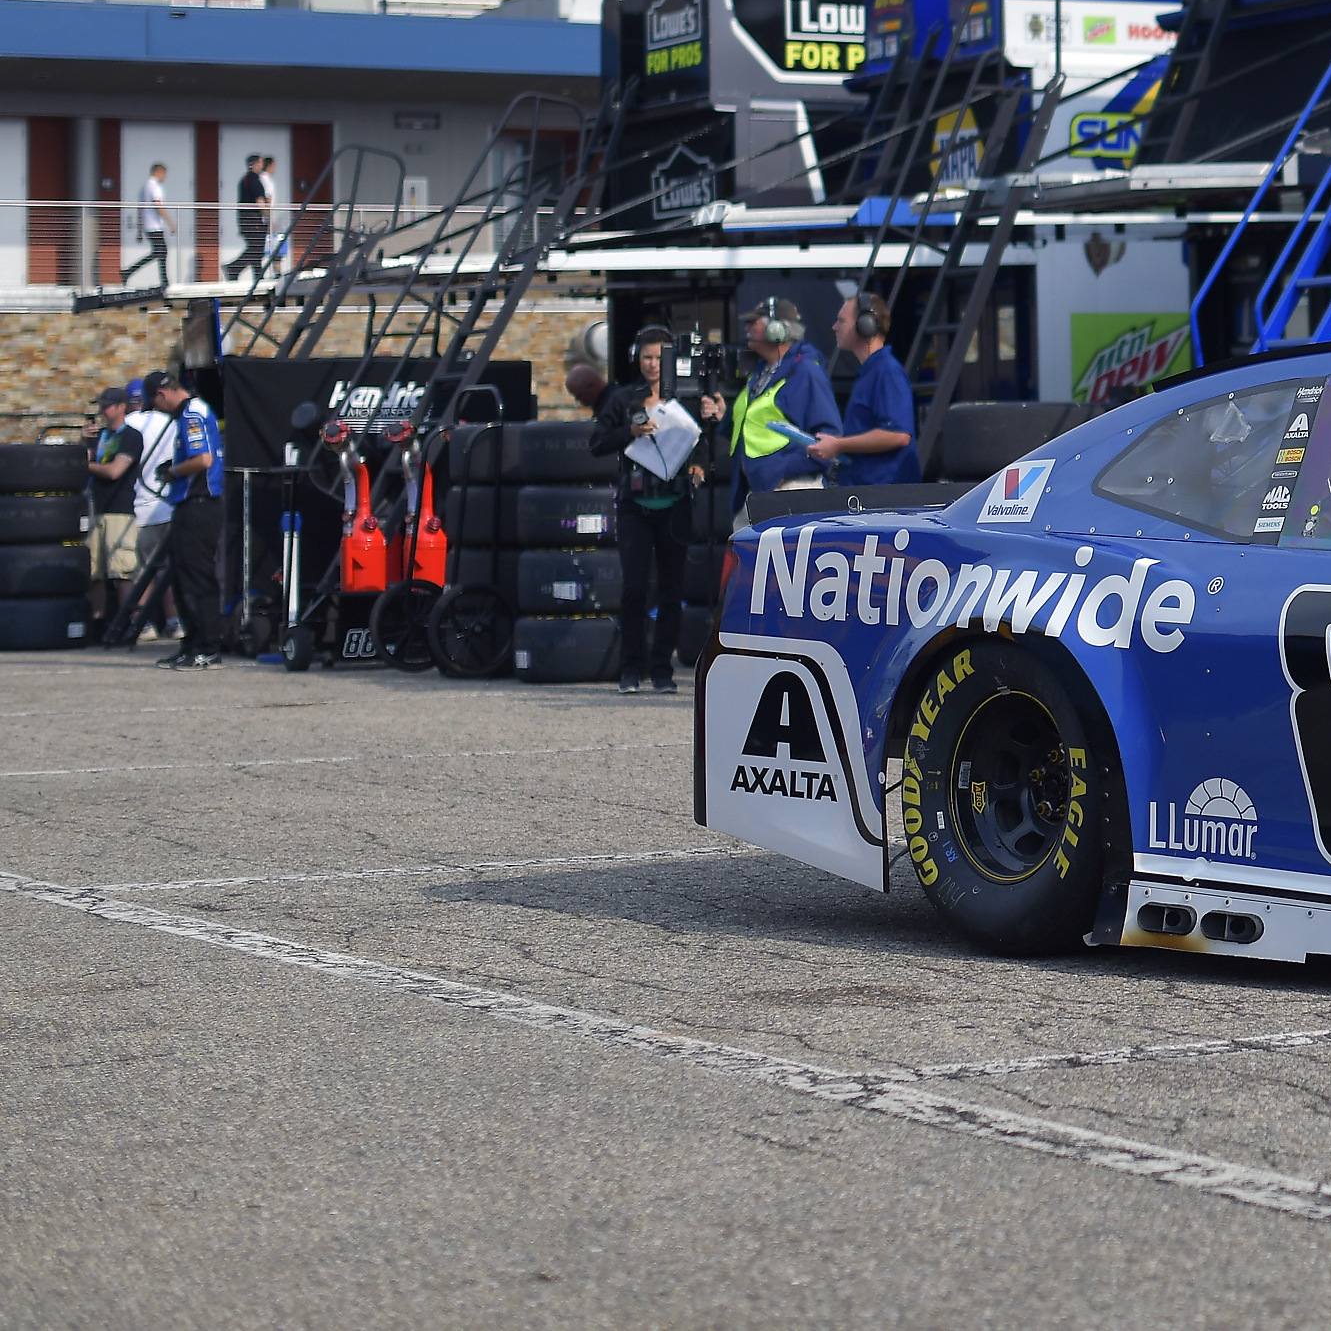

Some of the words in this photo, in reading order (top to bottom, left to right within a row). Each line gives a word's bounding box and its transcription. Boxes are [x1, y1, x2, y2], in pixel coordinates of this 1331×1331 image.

[647, 48, 669, 76] FOR
[671, 42, 703, 70] PROS
[785, 42, 840, 70] FOR
[1297, 386, 1325, 399] Hendrick
[1283, 431, 1309, 440] AXALTA
[1261, 502, 1290, 511] TOOLS
[1262, 485, 1291, 504] MAC
[986, 504, 1029, 516] Valvoline
[1256, 520, 1281, 530] SIEMENS
[750, 525, 1197, 653] Nationwide
[902, 648, 976, 887] GOODYEAR
[730, 764, 839, 803] AXALTA
[973, 785, 984, 809] AERO
[1052, 746, 1088, 880] EAGLE
[1149, 801, 1259, 859] LLumar
